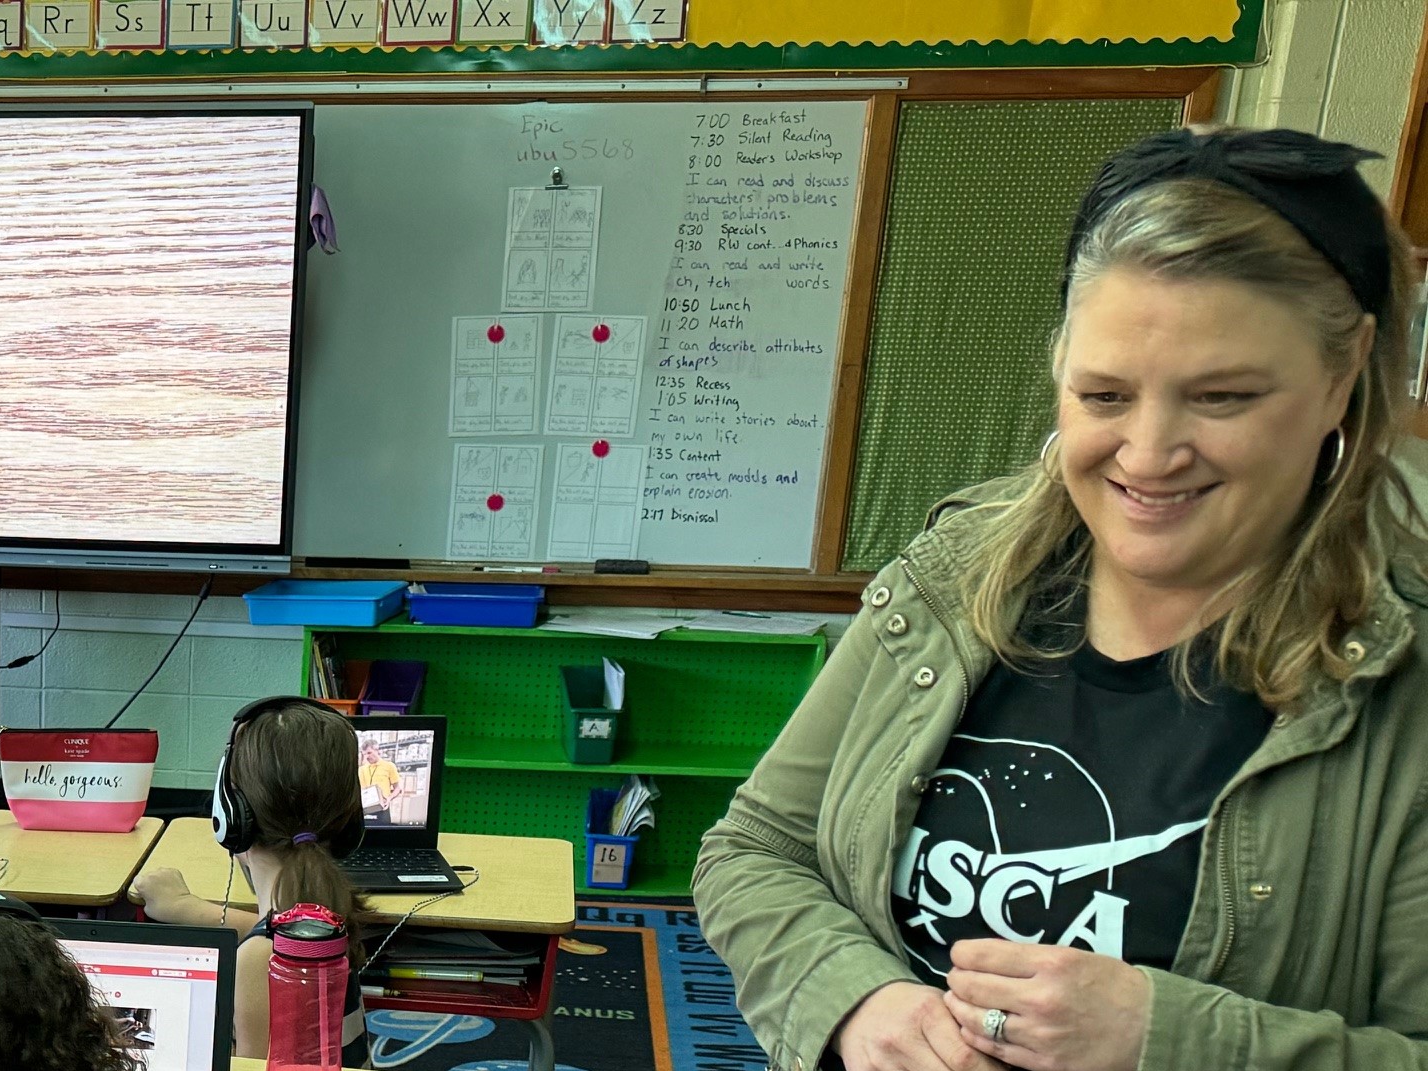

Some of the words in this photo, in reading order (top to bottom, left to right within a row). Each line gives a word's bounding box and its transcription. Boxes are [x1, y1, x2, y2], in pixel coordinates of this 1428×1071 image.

[44, 5, 74, 34] Rr
[115, 4, 144, 33] Ss
[190, 3, 214, 31] Tt
[253, 2, 291, 31] Uu
[742, 109, 807, 127] Breakfast
[521, 114, 563, 141] Epic
[690, 135, 725, 148] 7:30
[737, 131, 772, 145] Silent
[782, 128, 832, 148] Reading
[688, 154, 722, 169] 8:00
[785, 148, 843, 165] Workshop
[686, 172, 700, 186] I
[706, 177, 727, 187] can
[738, 175, 765, 187] read
[772, 176, 794, 187] and
[805, 175, 849, 187] discuss
[721, 224, 766, 238] Specials
[707, 275, 731, 288] tch
[786, 275, 830, 290] words
[664, 297, 699, 313] 10:50
[710, 297, 751, 312] Lunch
[709, 315, 744, 330] Math
[658, 337, 670, 350] I
[678, 341, 699, 351] can
[709, 336, 756, 353] describe
[765, 338, 823, 354] attributes
[659, 356, 673, 367] of
[676, 356, 718, 371] shapes
[655, 376, 685, 388] 12:35
[696, 376, 731, 390] Recess
[660, 471, 678, 480] can
[686, 469, 721, 482] create
[728, 468, 768, 484] models
[775, 470, 798, 484] and
[588, 722, 599, 733] A
[600, 846, 618, 863] 16
[554, 1006, 635, 1020] ANUS
